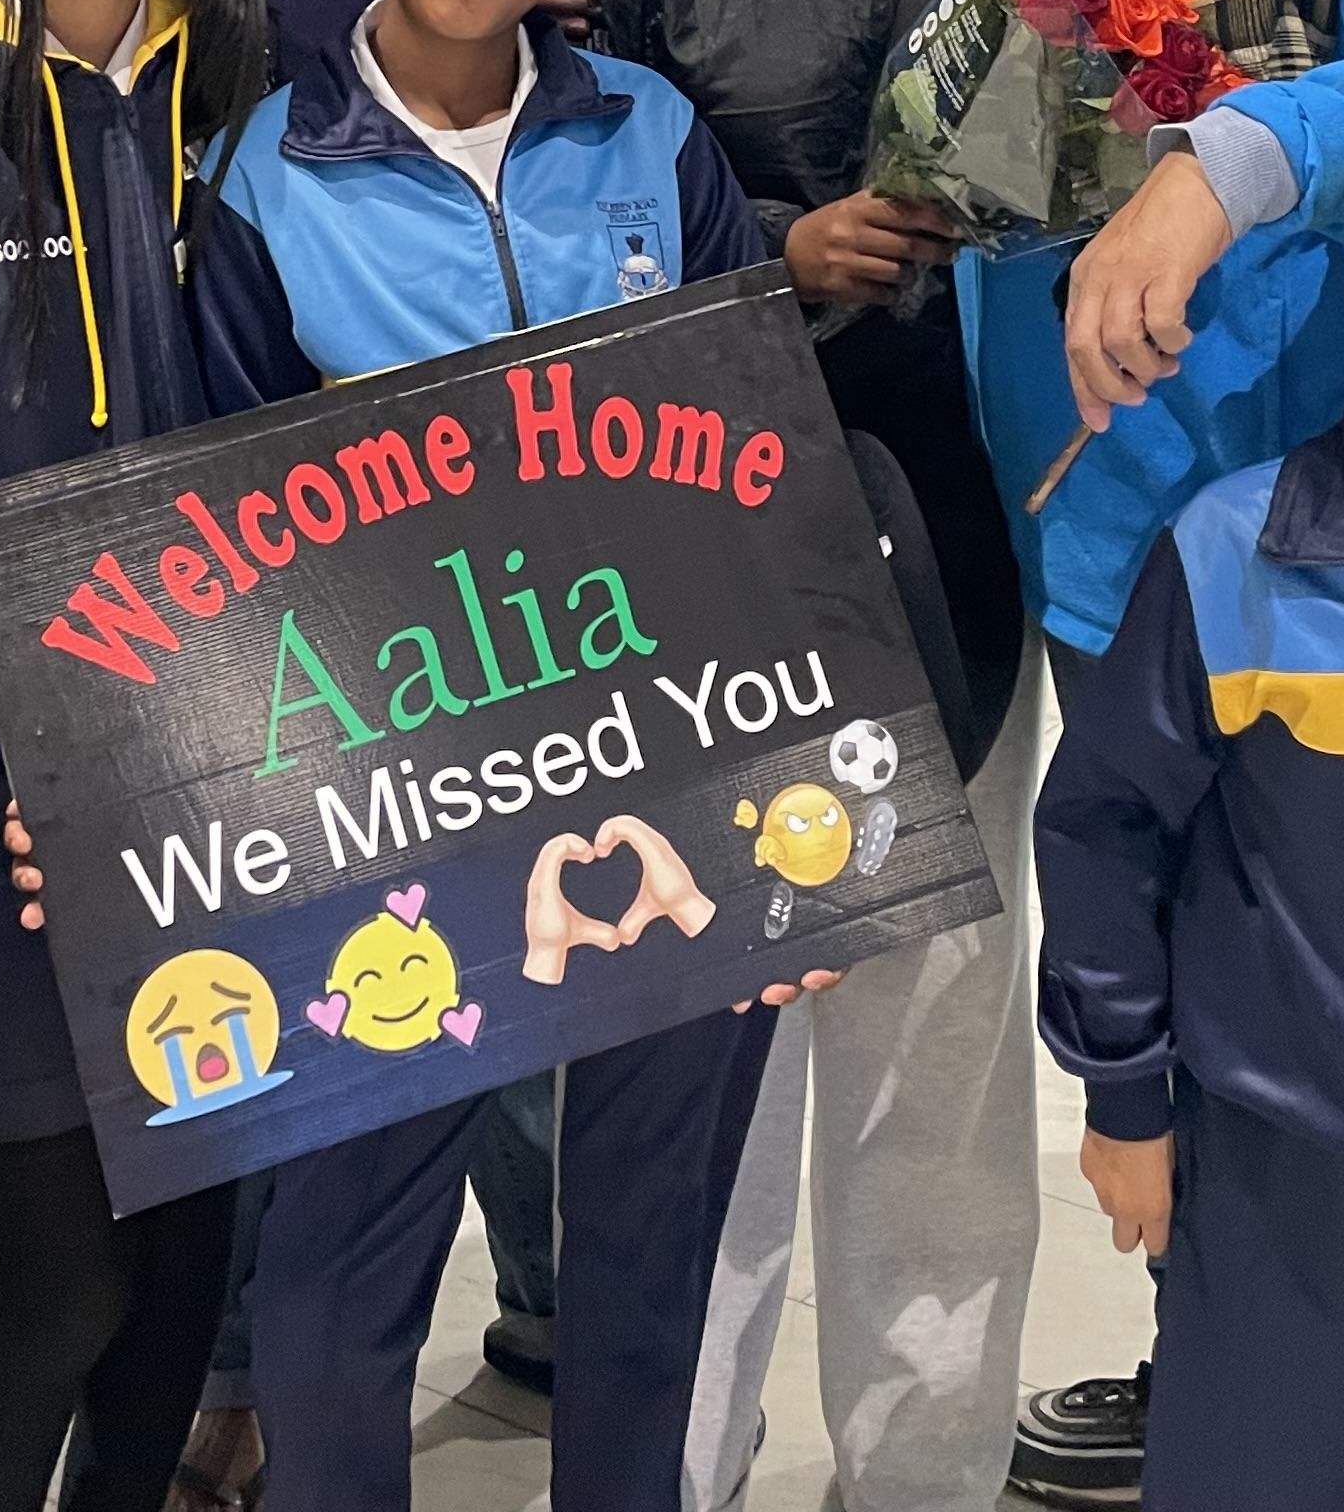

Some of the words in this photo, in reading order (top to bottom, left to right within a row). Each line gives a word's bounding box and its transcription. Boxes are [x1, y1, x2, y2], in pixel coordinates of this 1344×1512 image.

[40, 414, 476, 685] Welcome
[504, 362, 785, 508] Home
[120, 819, 292, 928] We
[313, 690, 645, 871] Missed
[653, 649, 835, 749] You
[252, 548, 658, 779] Aalia
